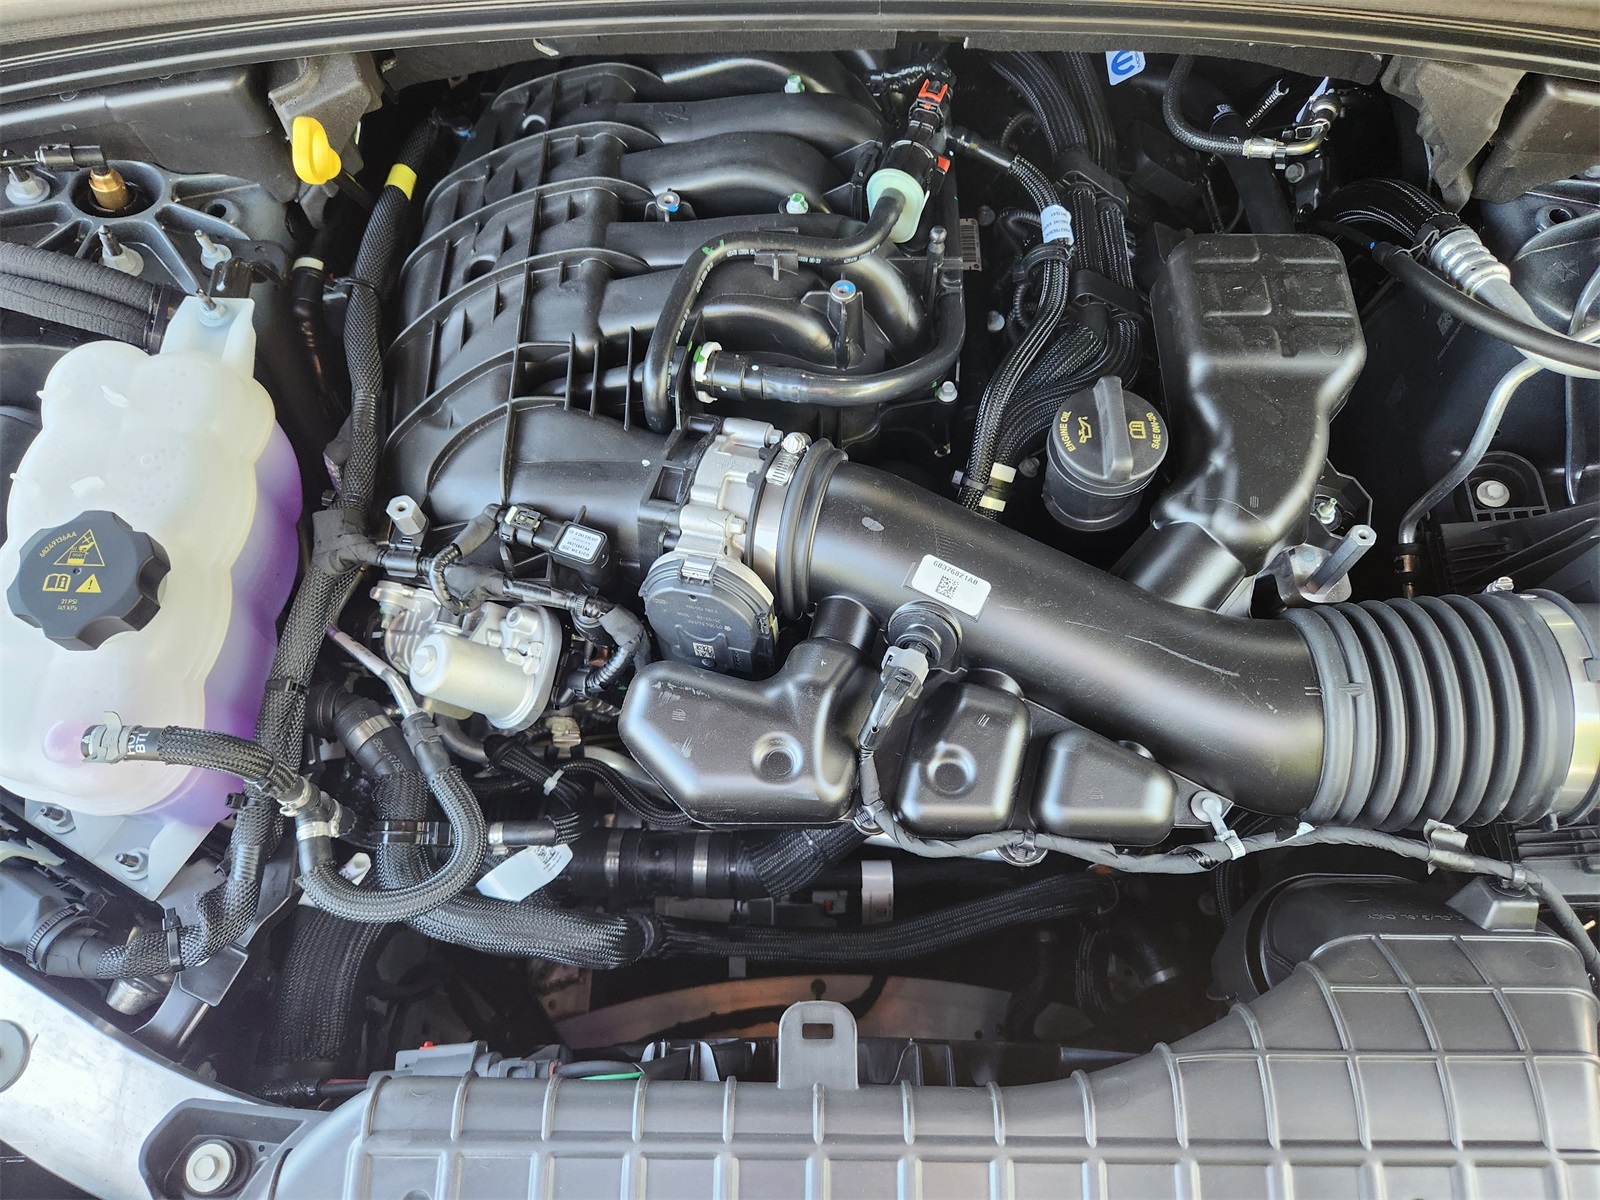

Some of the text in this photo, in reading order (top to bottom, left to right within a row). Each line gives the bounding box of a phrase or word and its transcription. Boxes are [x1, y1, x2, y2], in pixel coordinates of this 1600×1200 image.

[1059, 410, 1077, 453] ENGINE OIL
[1146, 412, 1162, 450] SAE 0W-20
[932, 560, 978, 586] 68376821AB
[136, 730, 151, 753] BTL
